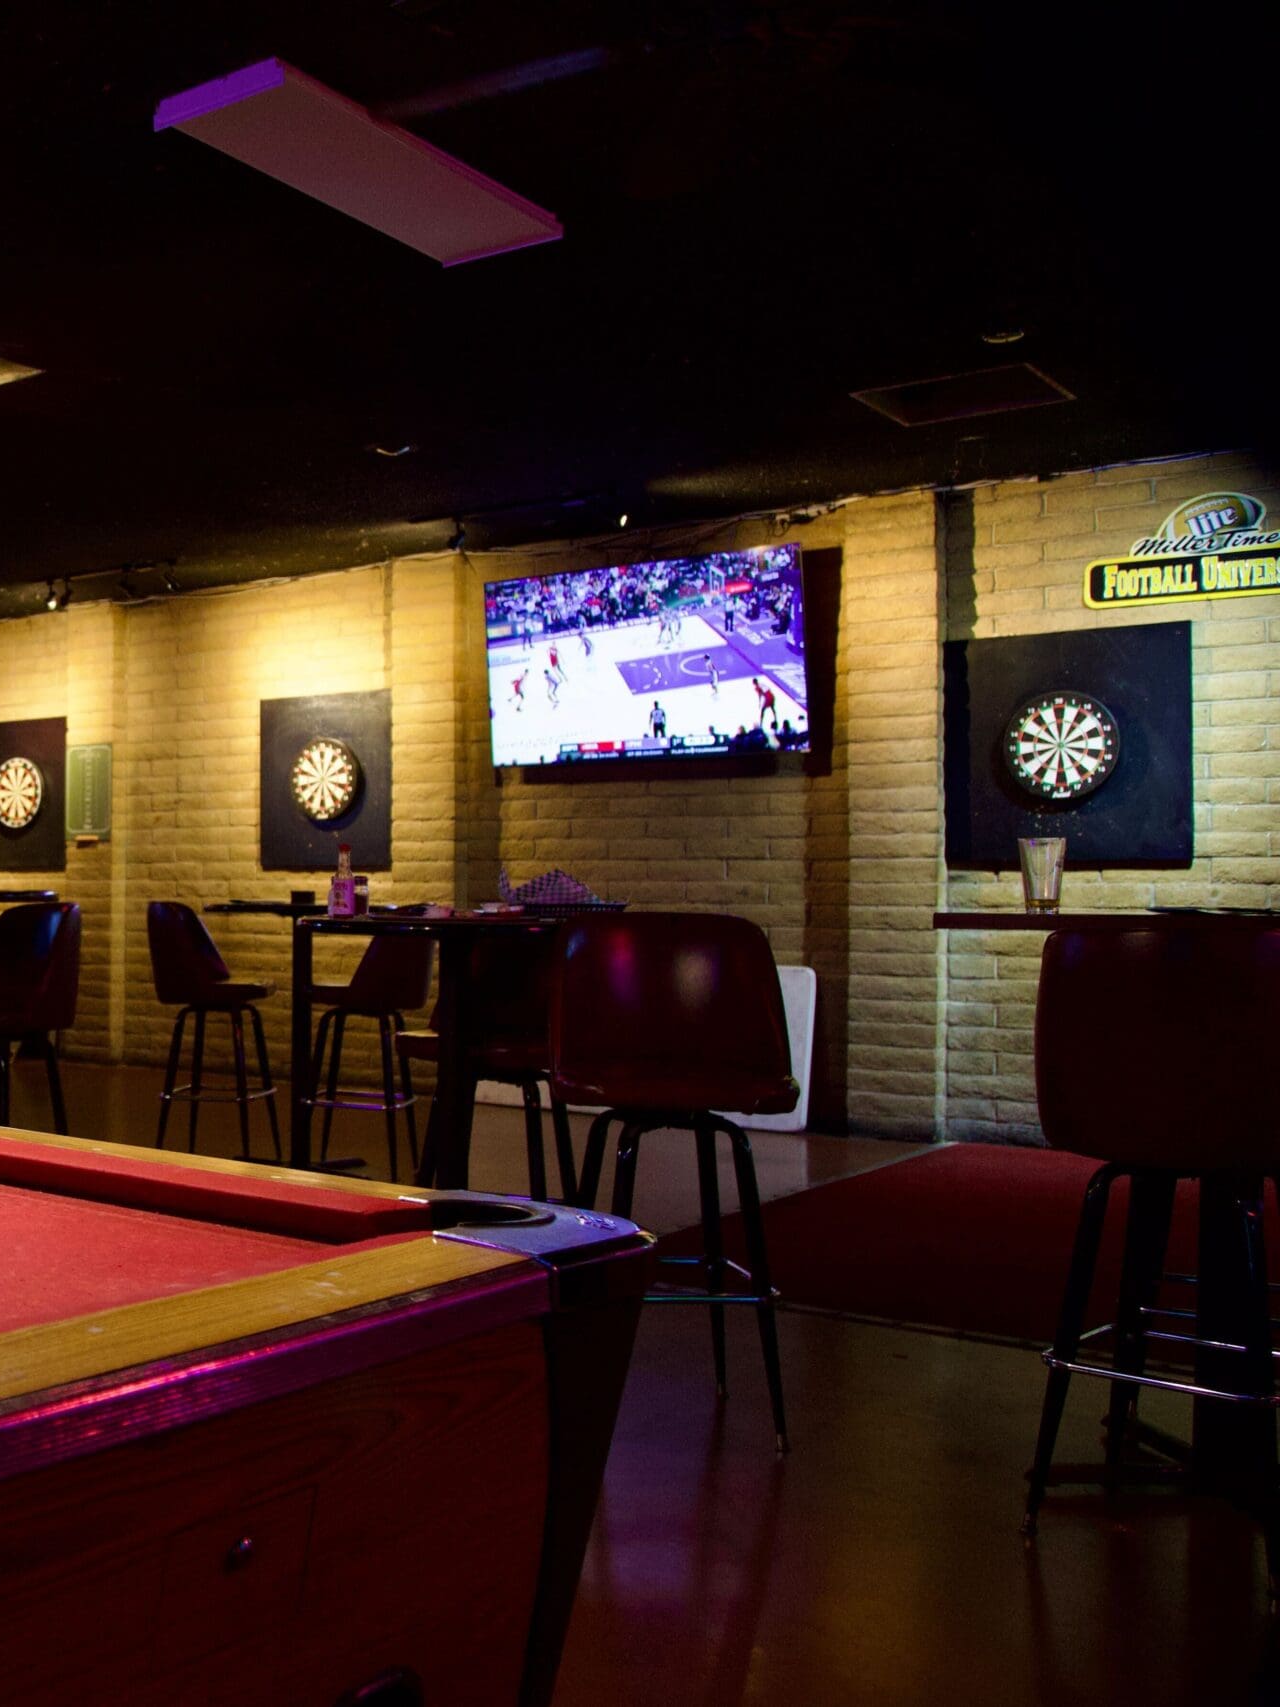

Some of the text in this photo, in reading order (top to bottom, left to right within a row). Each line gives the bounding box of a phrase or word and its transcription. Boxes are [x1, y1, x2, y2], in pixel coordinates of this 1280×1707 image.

[1186, 507, 1238, 540] lite
[1133, 527, 1280, 556] Miller Time
[1103, 555, 1280, 599] FOOTBALL UNIVER
